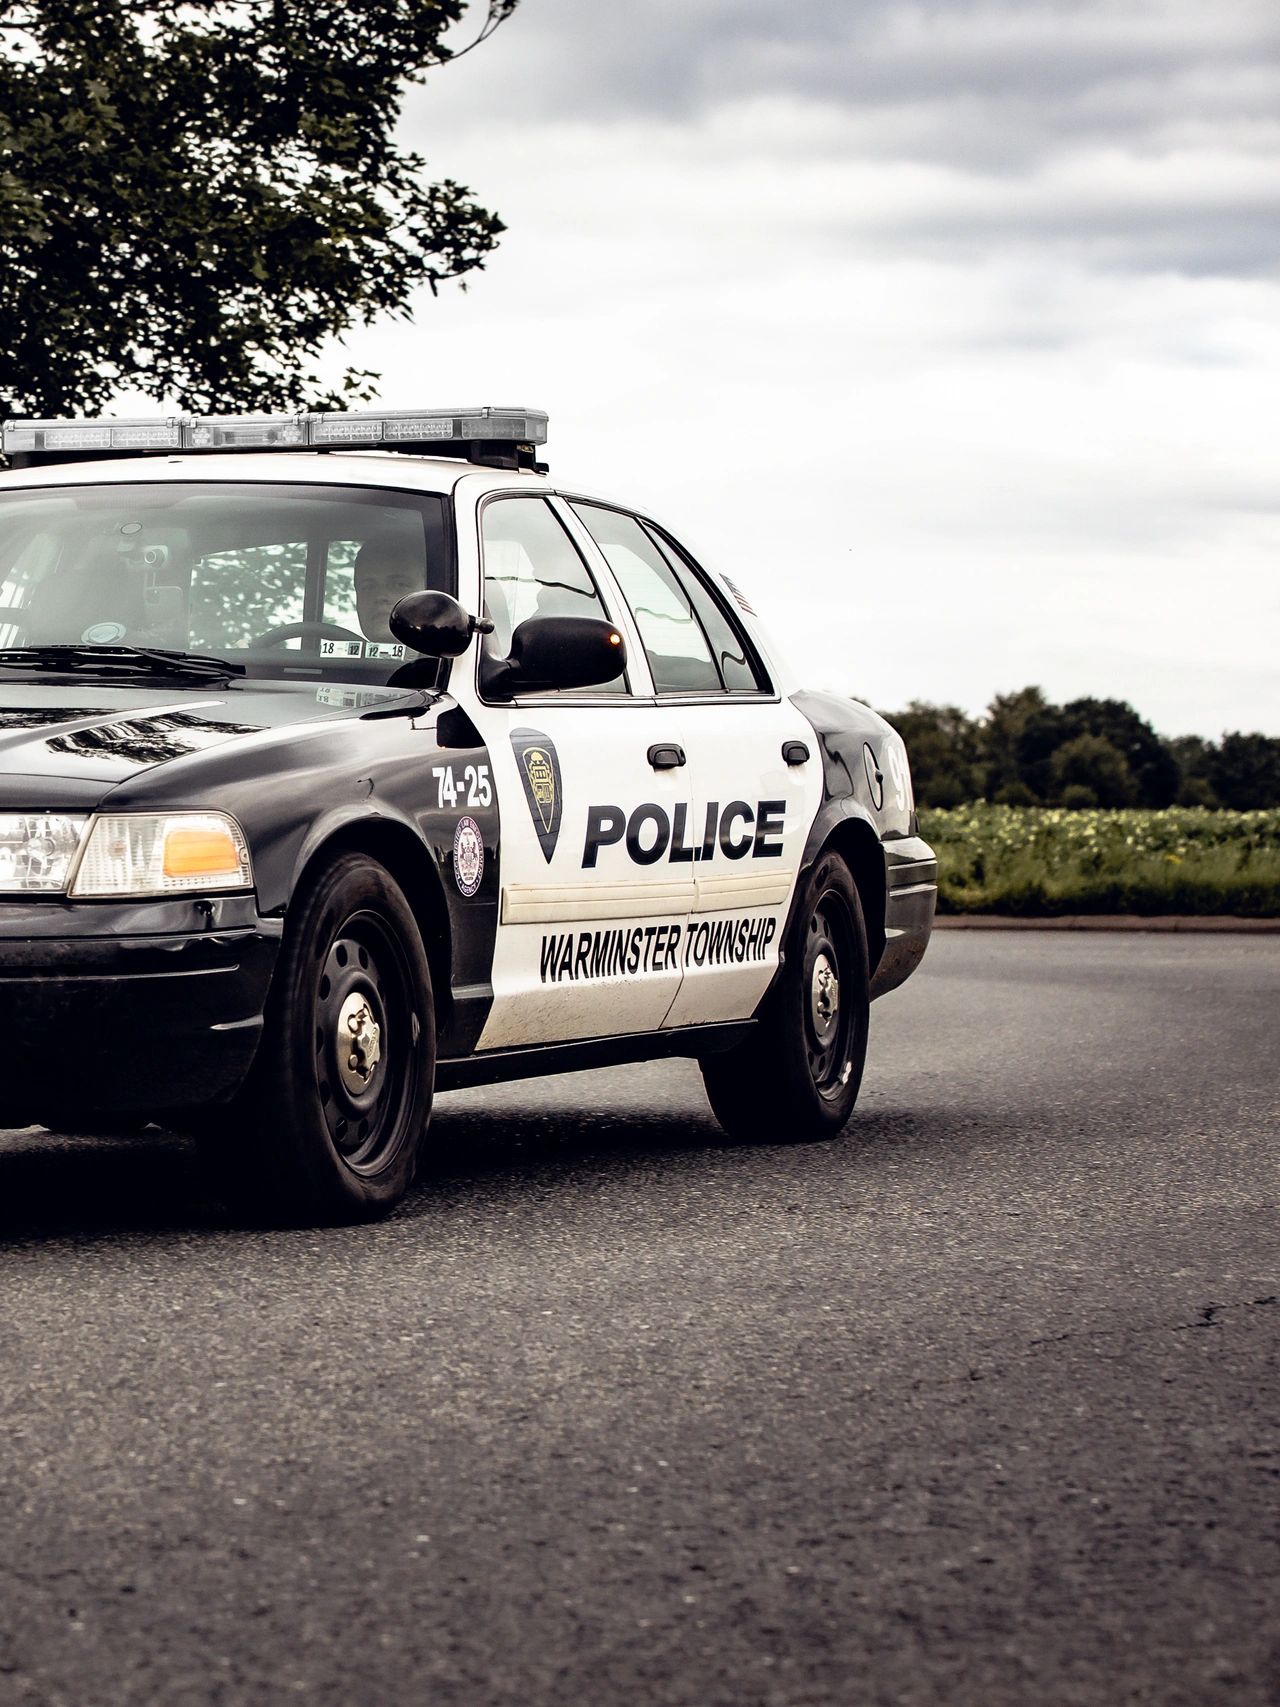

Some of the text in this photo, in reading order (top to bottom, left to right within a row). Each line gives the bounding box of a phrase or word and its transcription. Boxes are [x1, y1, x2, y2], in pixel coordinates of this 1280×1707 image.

[322, 643, 334, 654] 18
[431, 765, 492, 808] 74-25
[581, 800, 786, 869] POLICE
[540, 917, 776, 984] WARMINSTER TOWNSHIP
